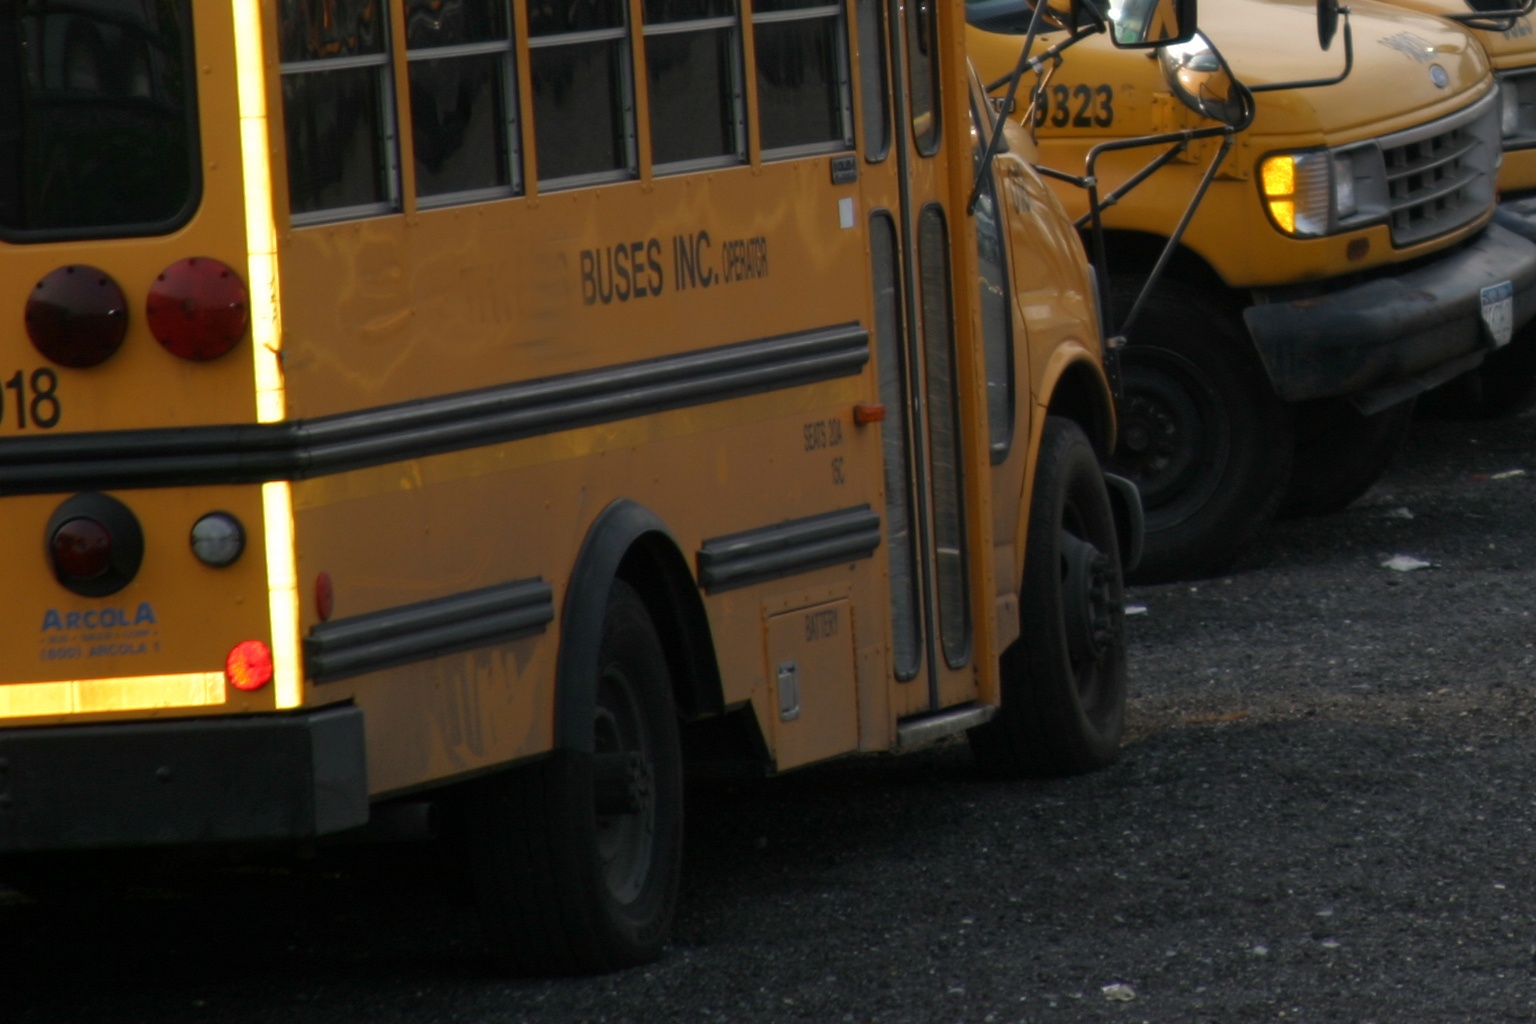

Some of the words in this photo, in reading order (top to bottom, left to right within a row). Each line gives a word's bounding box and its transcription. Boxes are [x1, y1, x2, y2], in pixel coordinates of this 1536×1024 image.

[1029, 83, 1114, 128] 9323
[579, 238, 664, 306] BUSES
[673, 229, 719, 291] INC.
[0, 367, 61, 428] 18
[42, 602, 157, 631] ARCOLA
